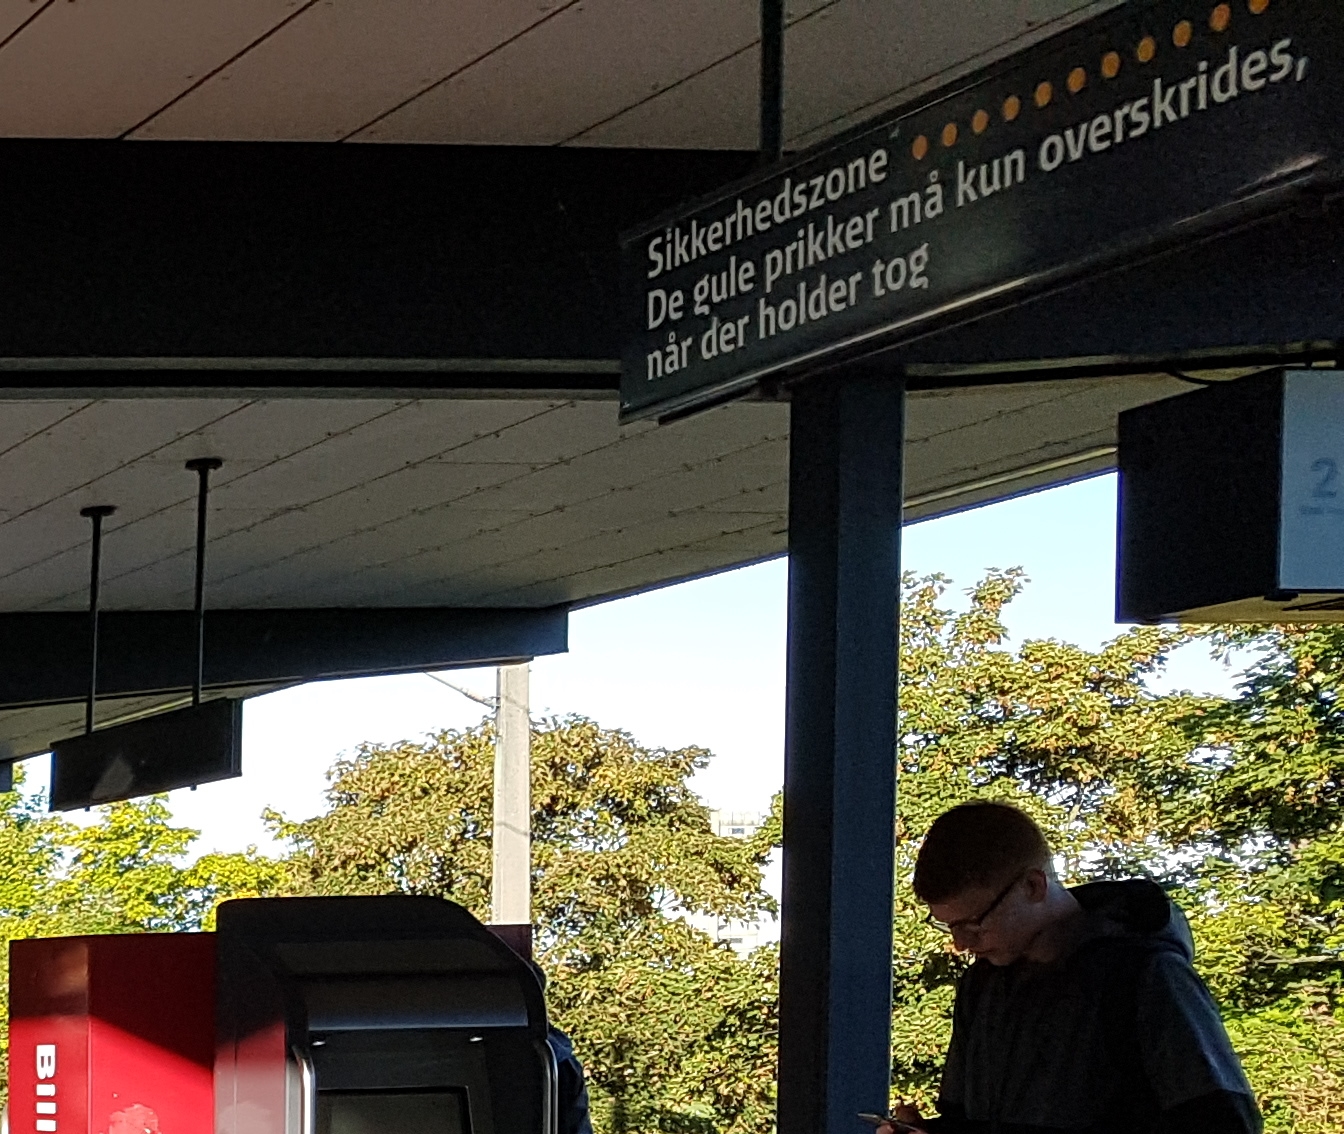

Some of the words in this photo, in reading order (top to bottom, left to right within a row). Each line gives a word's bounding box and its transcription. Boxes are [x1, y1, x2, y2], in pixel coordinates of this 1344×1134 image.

[647, 289, 684, 330] De
[693, 255, 756, 316] gule
[765, 208, 880, 294] prikker
[890, 170, 944, 233] må
[955, 149, 1026, 208] kun
[1038, 38, 1311, 173] overskrides,
[648, 149, 888, 279] Sikkerhedszone
[647, 331, 693, 381] når
[700, 315, 750, 361] der
[758, 271, 862, 340] holder
[871, 242, 930, 297] tog
